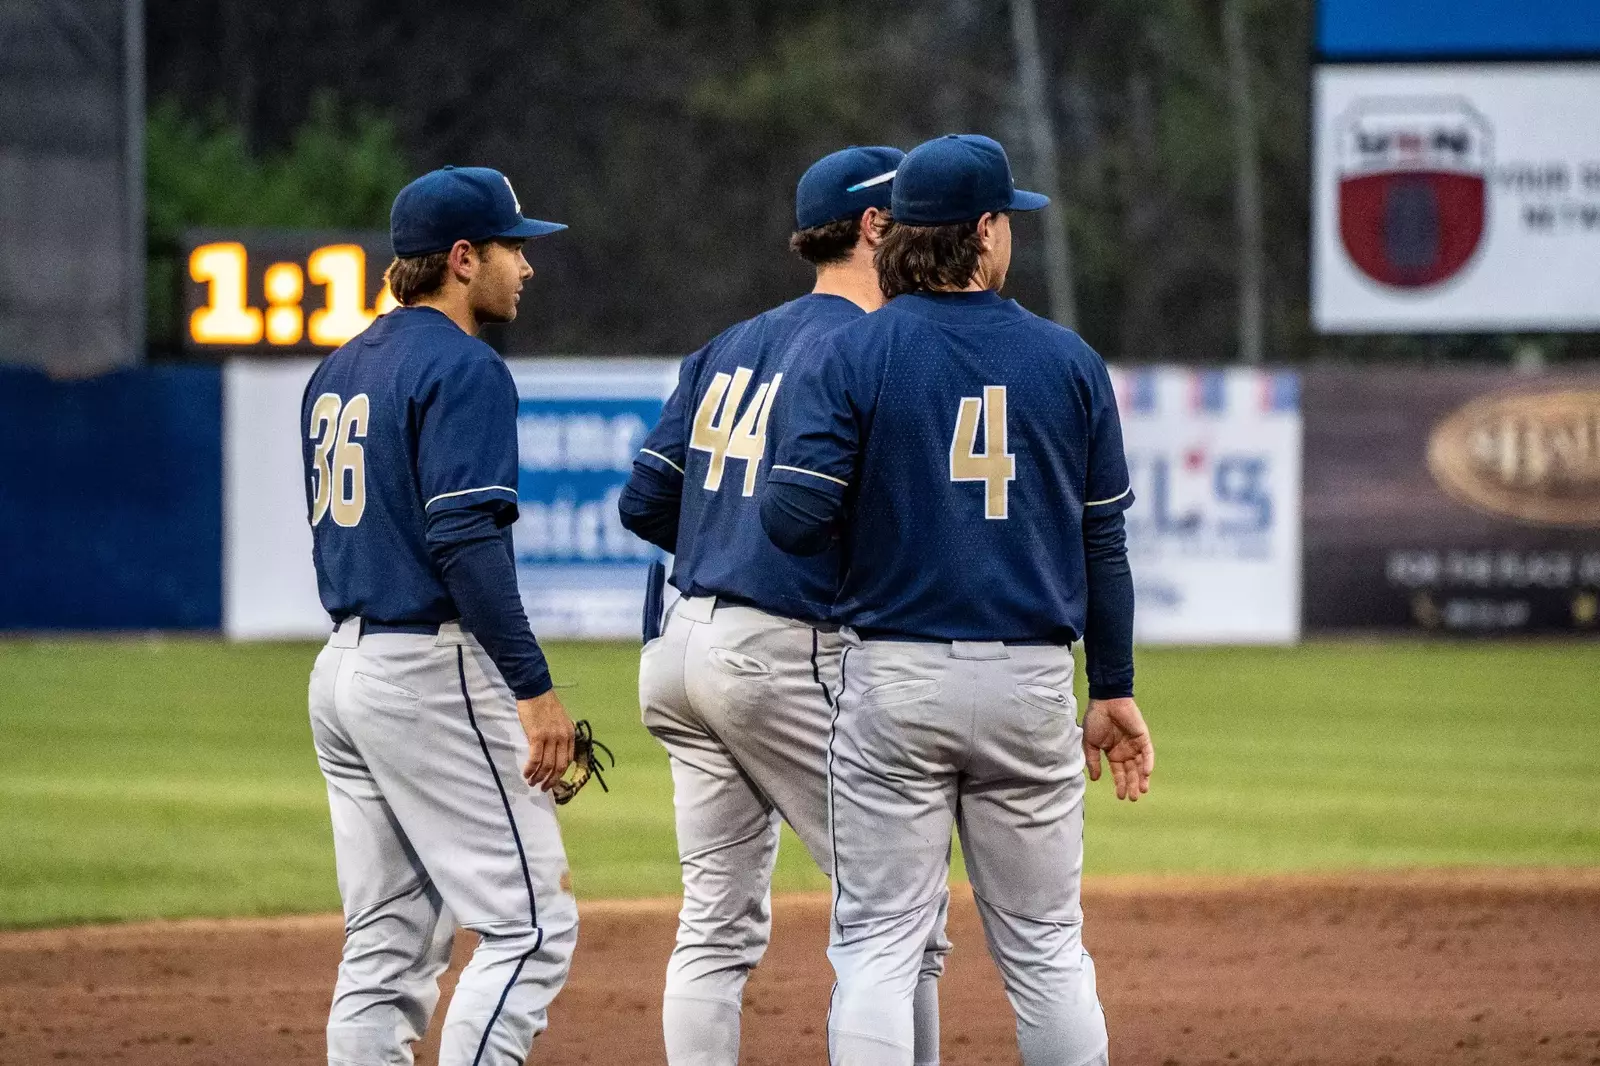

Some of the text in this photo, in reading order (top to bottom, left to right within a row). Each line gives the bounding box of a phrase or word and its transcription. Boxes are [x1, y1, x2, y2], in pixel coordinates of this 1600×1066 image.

[188, 242, 402, 347] 1:1
[309, 393, 370, 528] 36
[689, 366, 783, 497] 44
[949, 385, 1016, 520] 4
